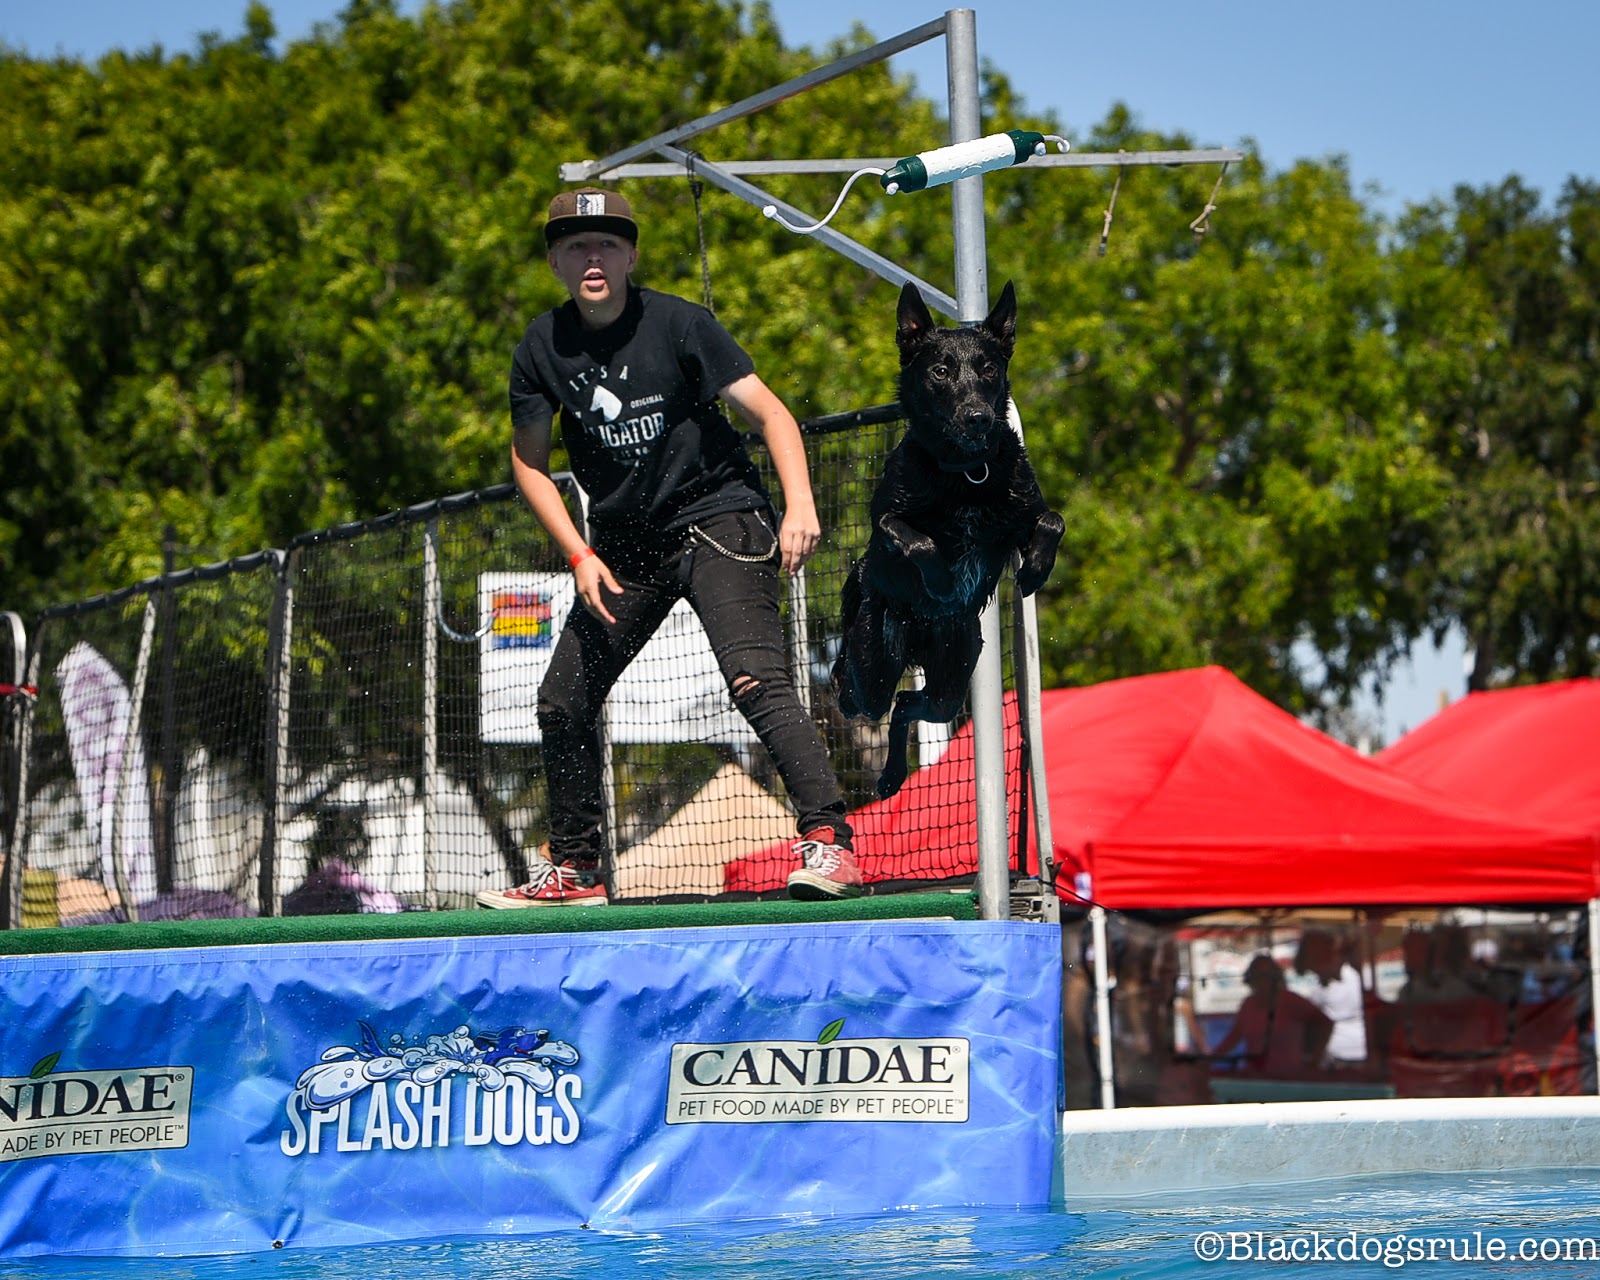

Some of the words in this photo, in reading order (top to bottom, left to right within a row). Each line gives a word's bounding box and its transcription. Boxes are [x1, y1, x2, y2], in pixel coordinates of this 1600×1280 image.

[569, 365, 608, 391] IT'S
[619, 365, 628, 380] A
[630, 393, 664, 409] ORIGINAL
[582, 411, 664, 447] IGATOR
[280, 1079, 450, 1157] SPLASH
[464, 1073, 582, 1146] DOGS
[678, 1100, 707, 1117] PET
[712, 1099, 766, 1116] FOOD
[772, 1098, 824, 1116] MADE
[830, 1098, 850, 1115] BY
[856, 1098, 884, 1115] PET
[45, 1131, 66, 1149] BY
[72, 1129, 104, 1147] PET
